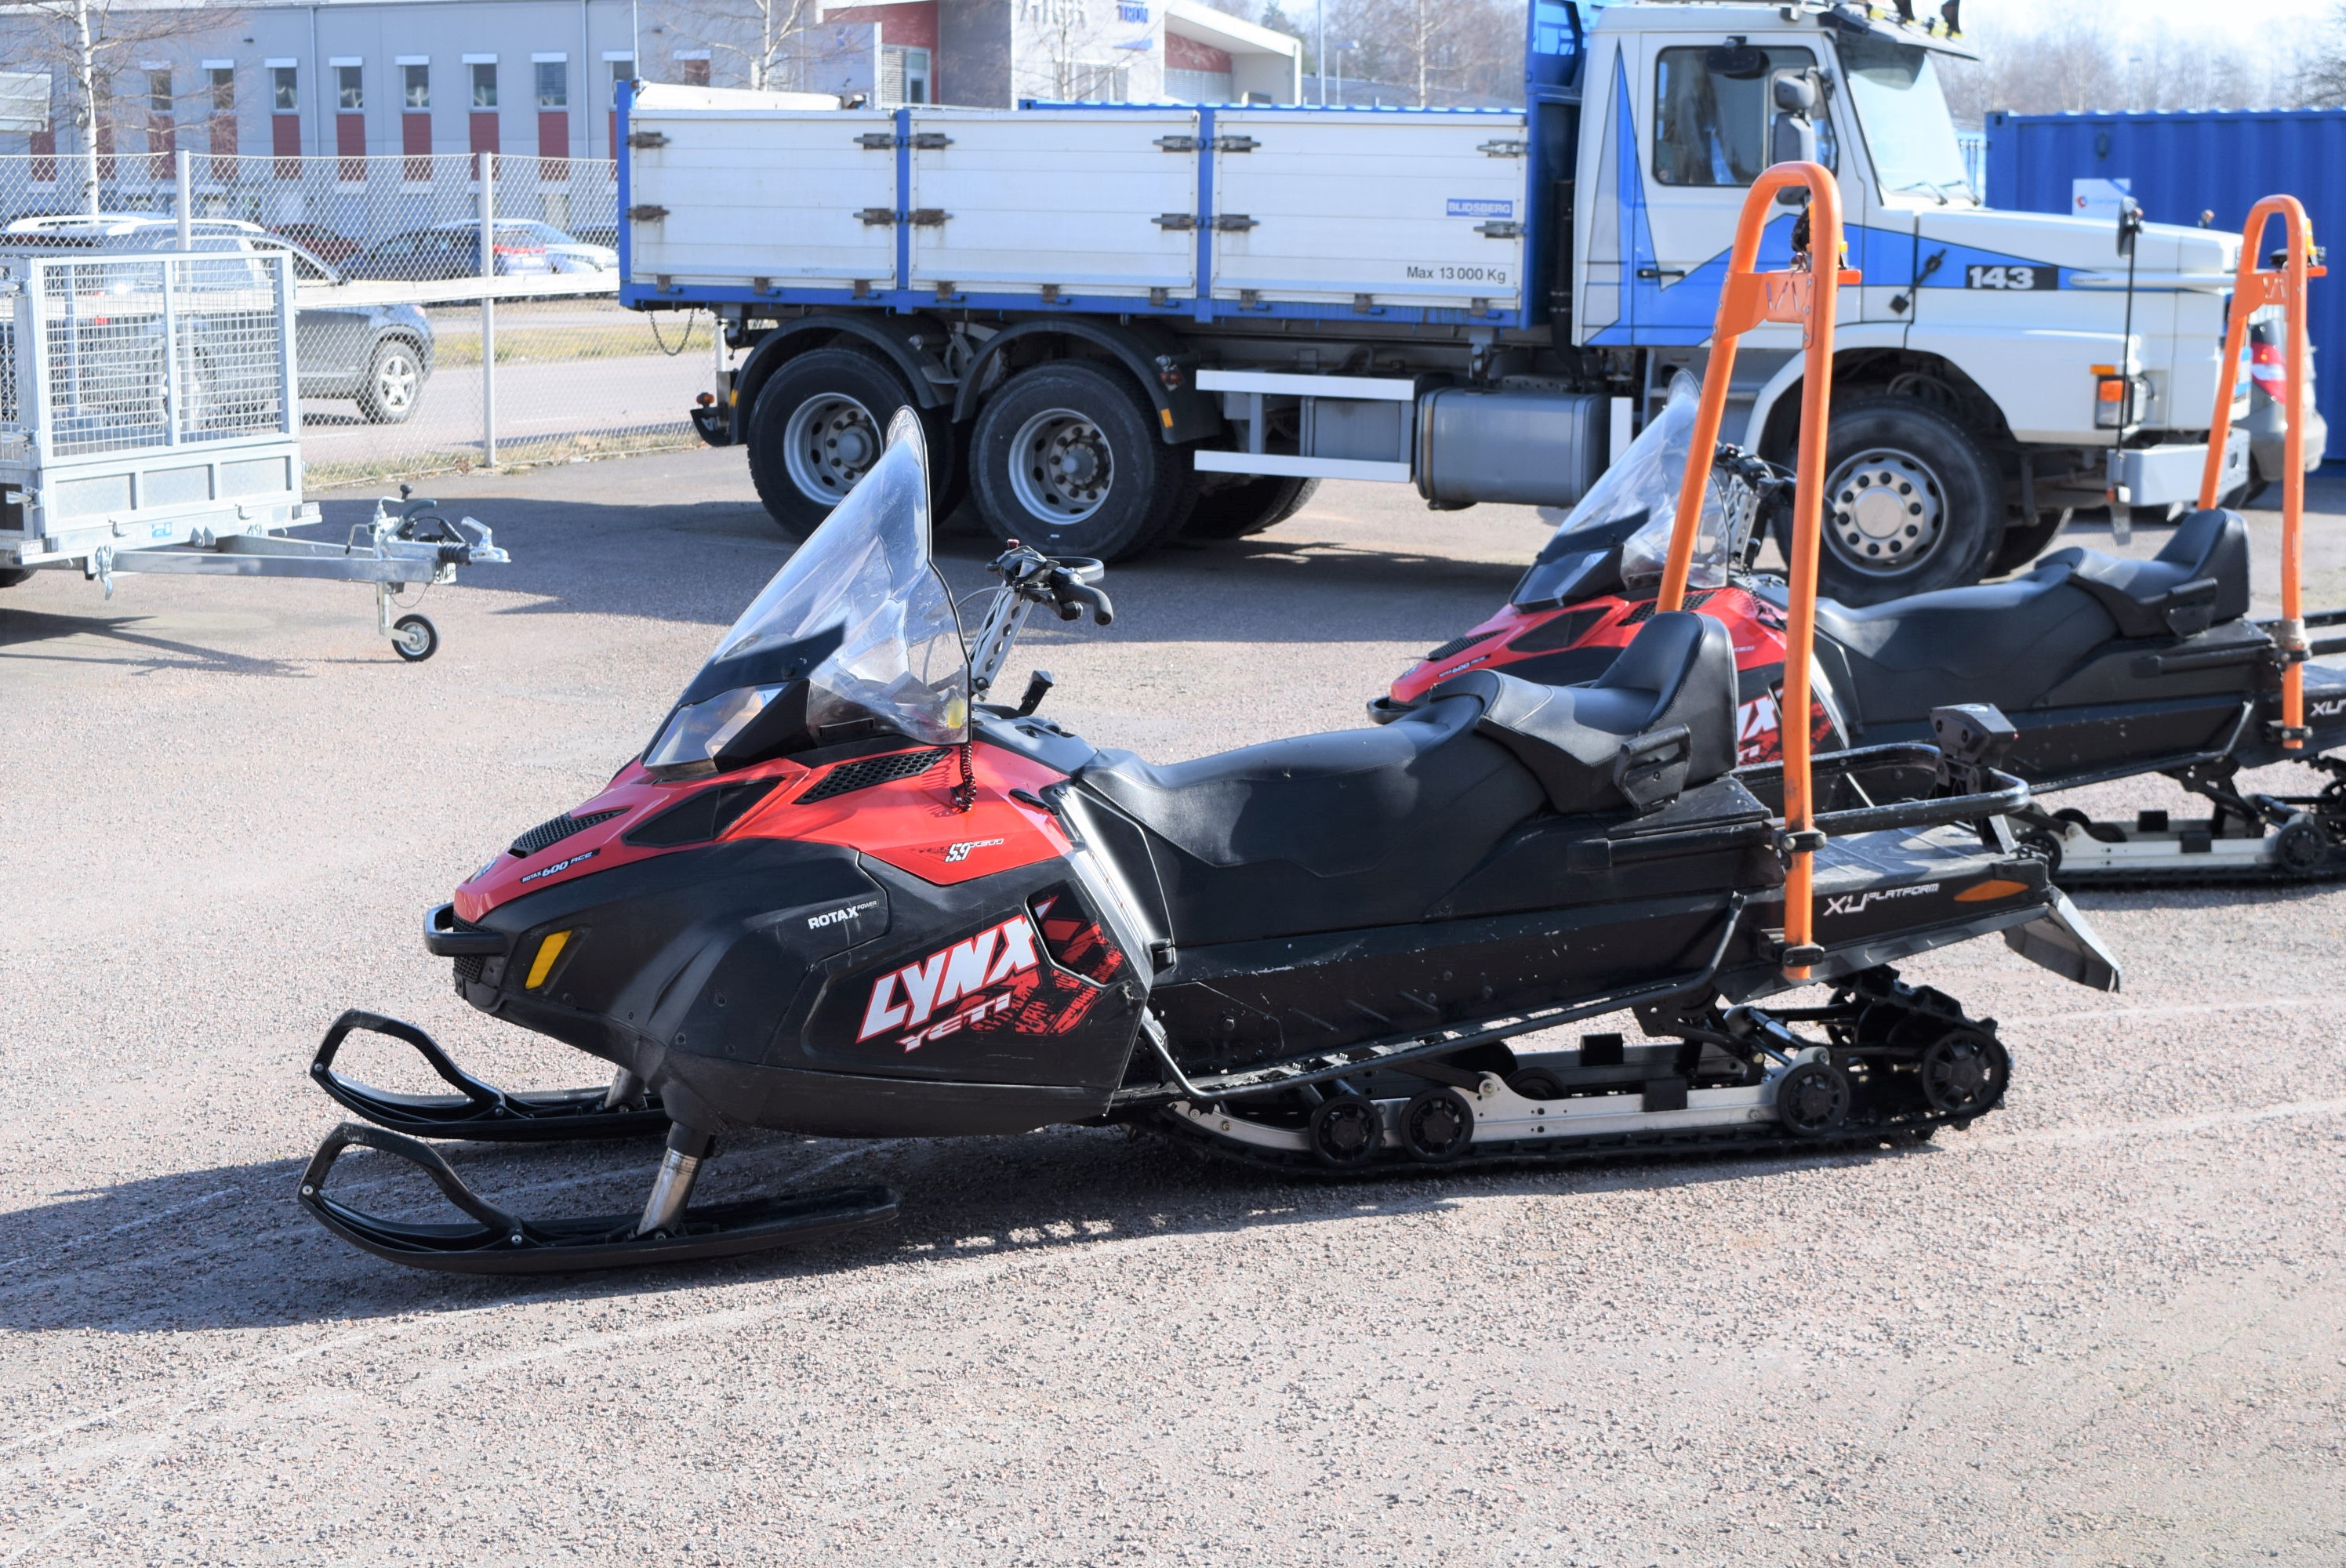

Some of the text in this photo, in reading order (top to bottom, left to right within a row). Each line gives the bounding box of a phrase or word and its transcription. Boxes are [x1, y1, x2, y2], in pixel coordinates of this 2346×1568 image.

[1447, 201, 1511, 214] BLIDSBERG
[1407, 266, 1434, 278] Max
[1487, 269, 1506, 285] Kg
[1969, 266, 2035, 290] 143
[521, 851, 593, 883] ROTAX 600 ACE
[1867, 882, 1941, 901] PLATFORM
[808, 900, 877, 930] ROTAX POWER
[855, 913, 1040, 1044] LYNX
[895, 990, 1013, 1053] YETI
